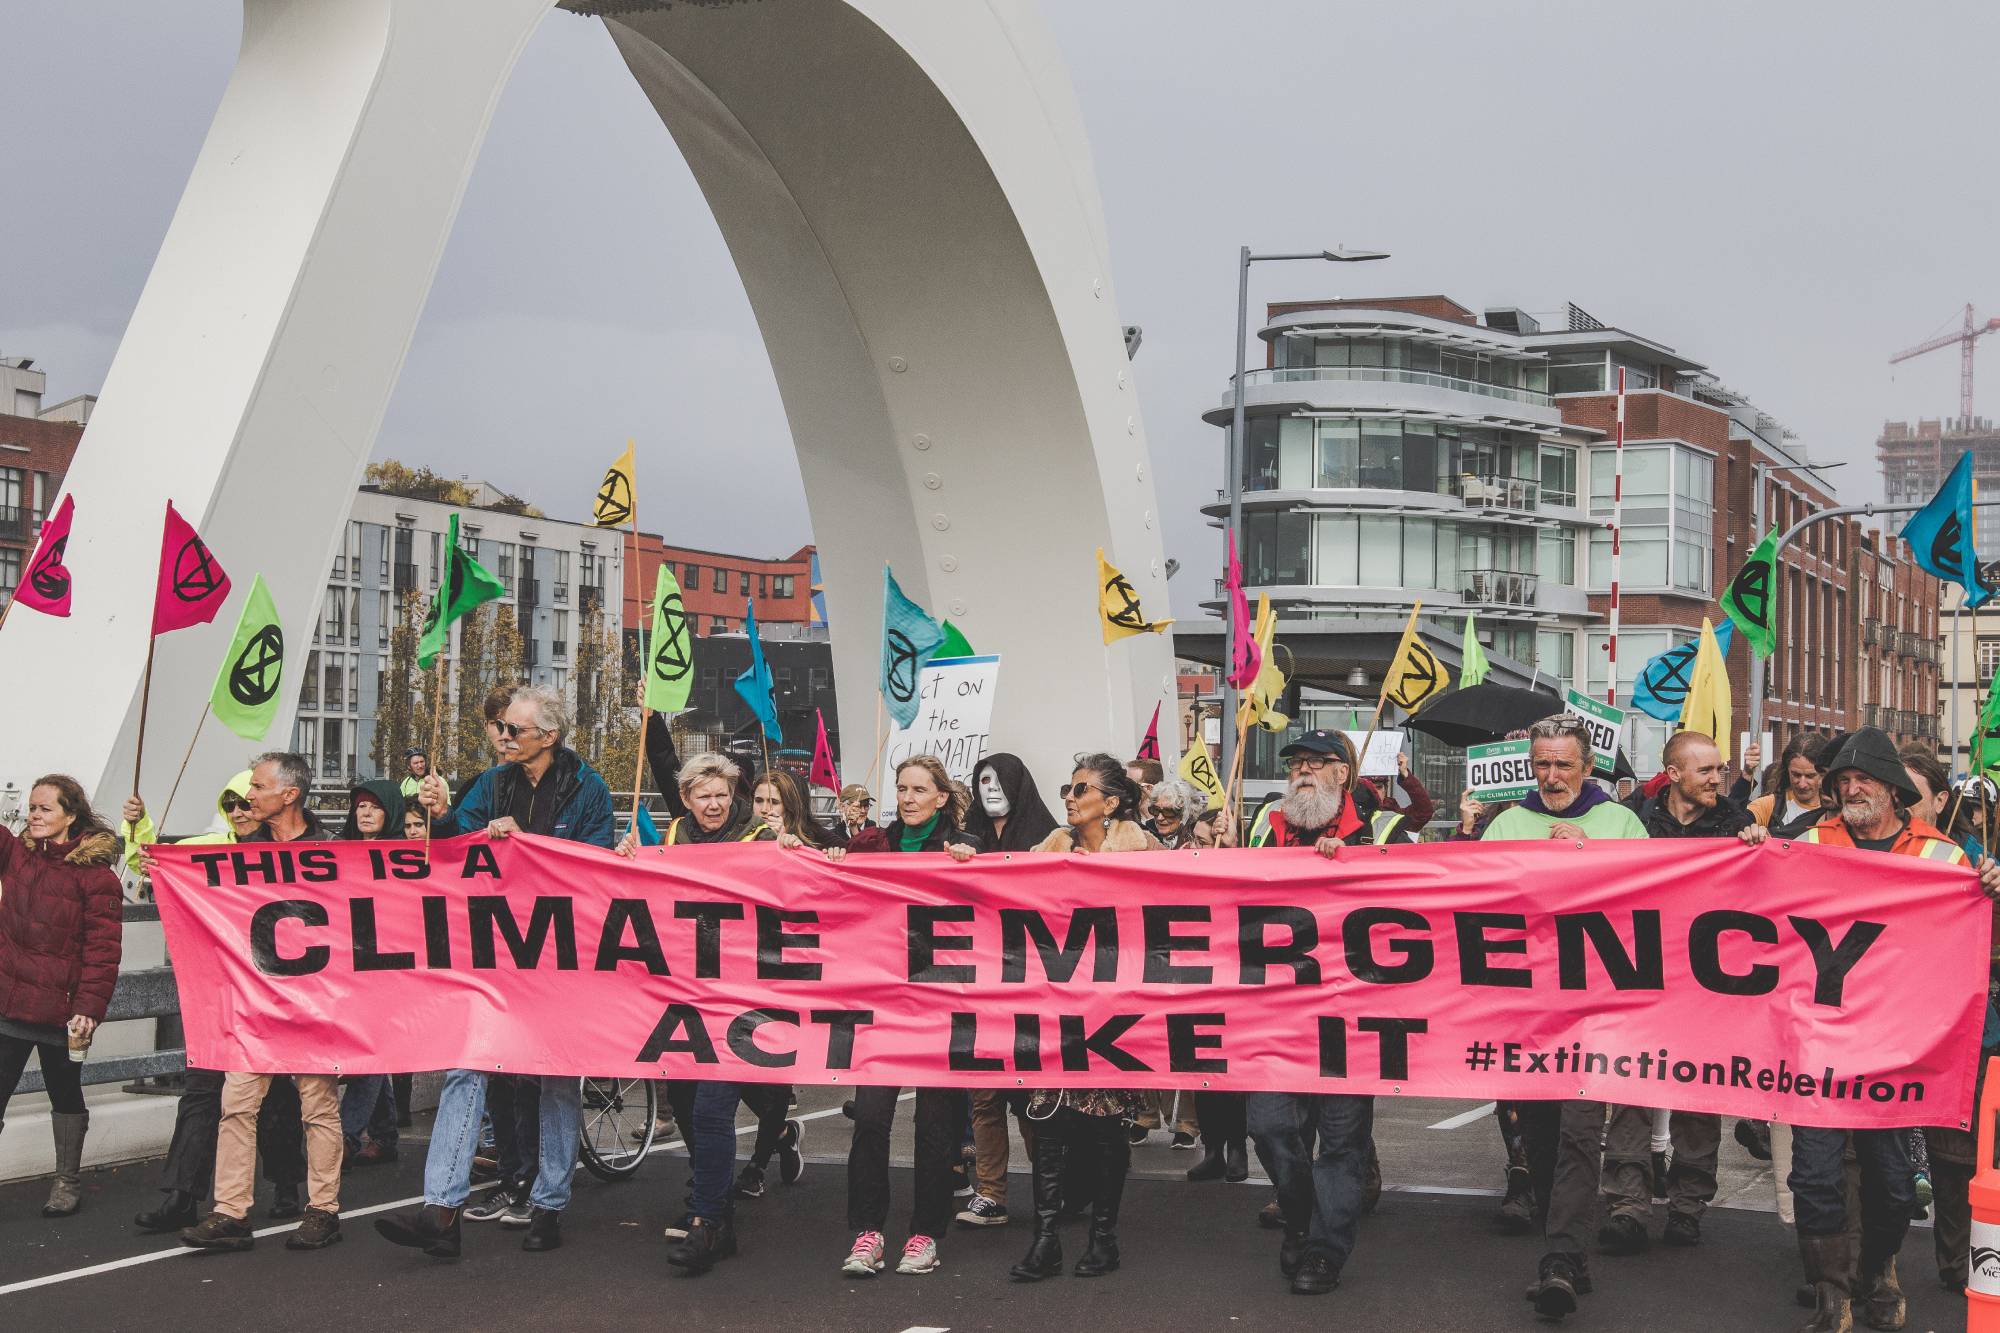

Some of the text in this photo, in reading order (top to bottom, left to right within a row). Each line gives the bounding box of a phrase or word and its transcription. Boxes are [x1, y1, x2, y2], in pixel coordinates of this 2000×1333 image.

[920, 673, 984, 699] ct ON
[928, 708, 961, 732] the
[1566, 708, 1615, 751] SED
[1486, 790, 1516, 799] CLIMATE
[191, 843, 502, 887] THIS IS A
[249, 896, 1888, 1007] CLIMATE EMERGENCY
[635, 1003, 1428, 1081] ACT LIKE IT
